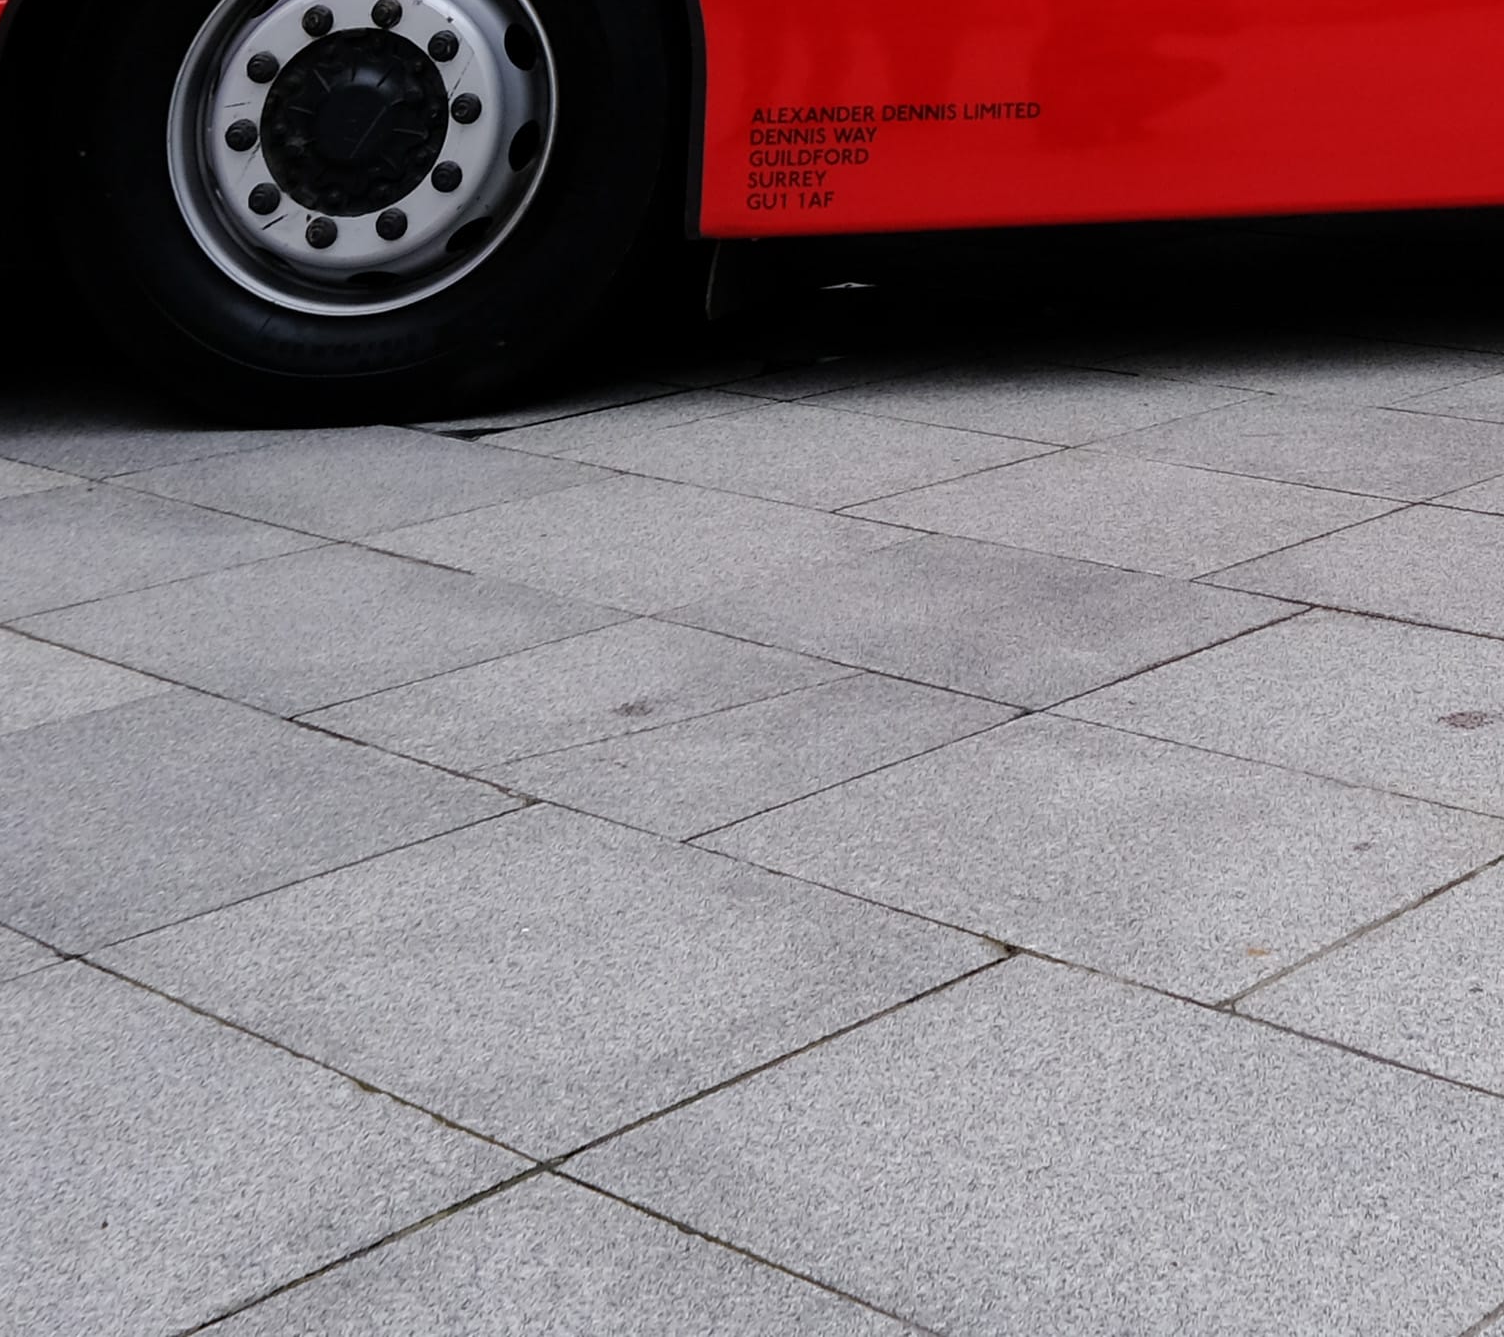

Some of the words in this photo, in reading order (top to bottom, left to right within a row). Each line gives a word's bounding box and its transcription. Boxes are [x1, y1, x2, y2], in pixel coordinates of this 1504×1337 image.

[751, 106, 876, 125] ALEXANDER
[881, 103, 957, 122] DENNIS
[963, 102, 1041, 120] LIMITED
[750, 127, 826, 145] DENNIS
[834, 127, 878, 143] WAY
[749, 148, 870, 167] GUILDFORD
[747, 170, 827, 189] SURREY
[746, 193, 788, 210] GU1
[798, 191, 835, 209] 1AF
